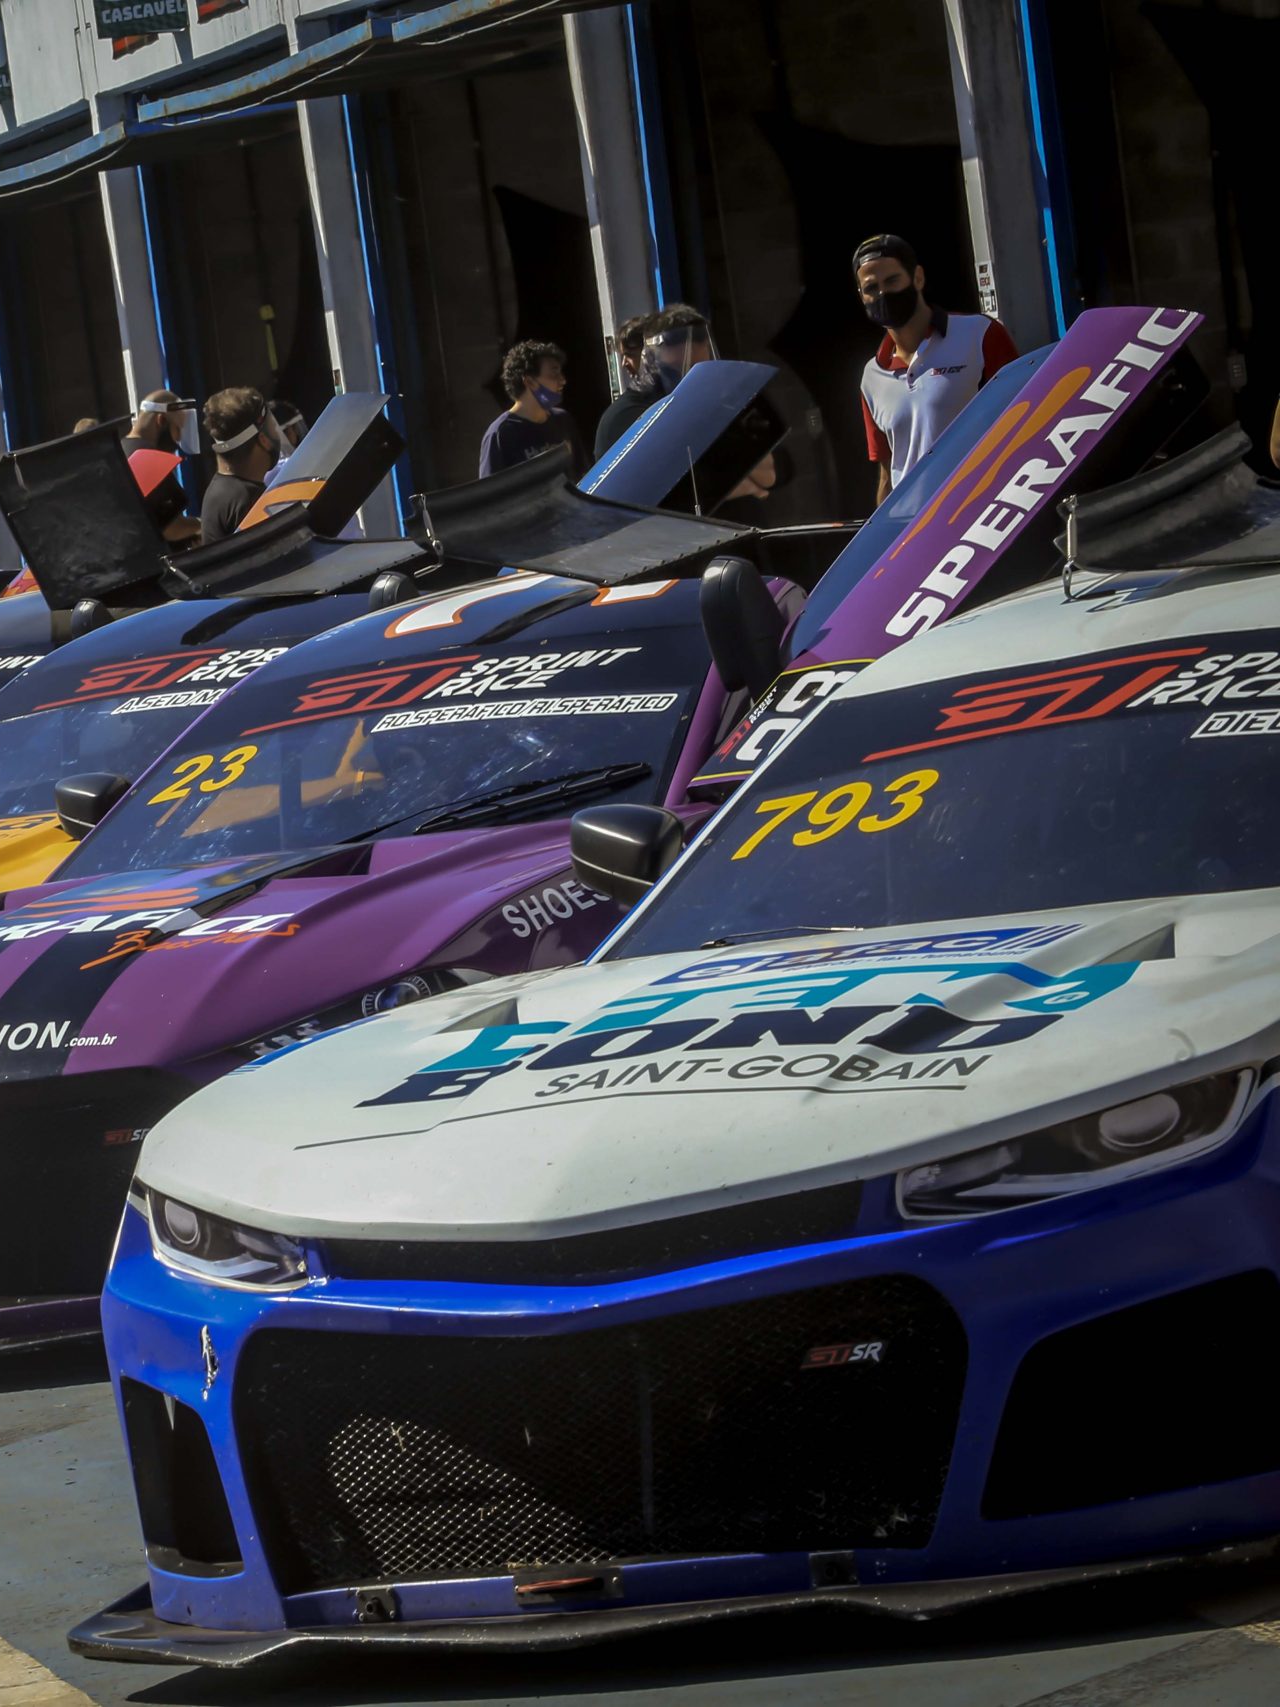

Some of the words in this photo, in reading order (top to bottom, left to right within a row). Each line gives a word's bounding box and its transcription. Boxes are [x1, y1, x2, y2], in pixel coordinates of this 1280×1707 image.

[102, 0, 187, 24] CASCAVEL
[422, 668, 565, 699] RACE
[460, 647, 643, 679] SPRINT
[147, 745, 258, 806] 23
[731, 769, 939, 861] 793
[353, 1003, 1065, 1108] BOND
[535, 1054, 993, 1098] SAINT-GOBAIN
